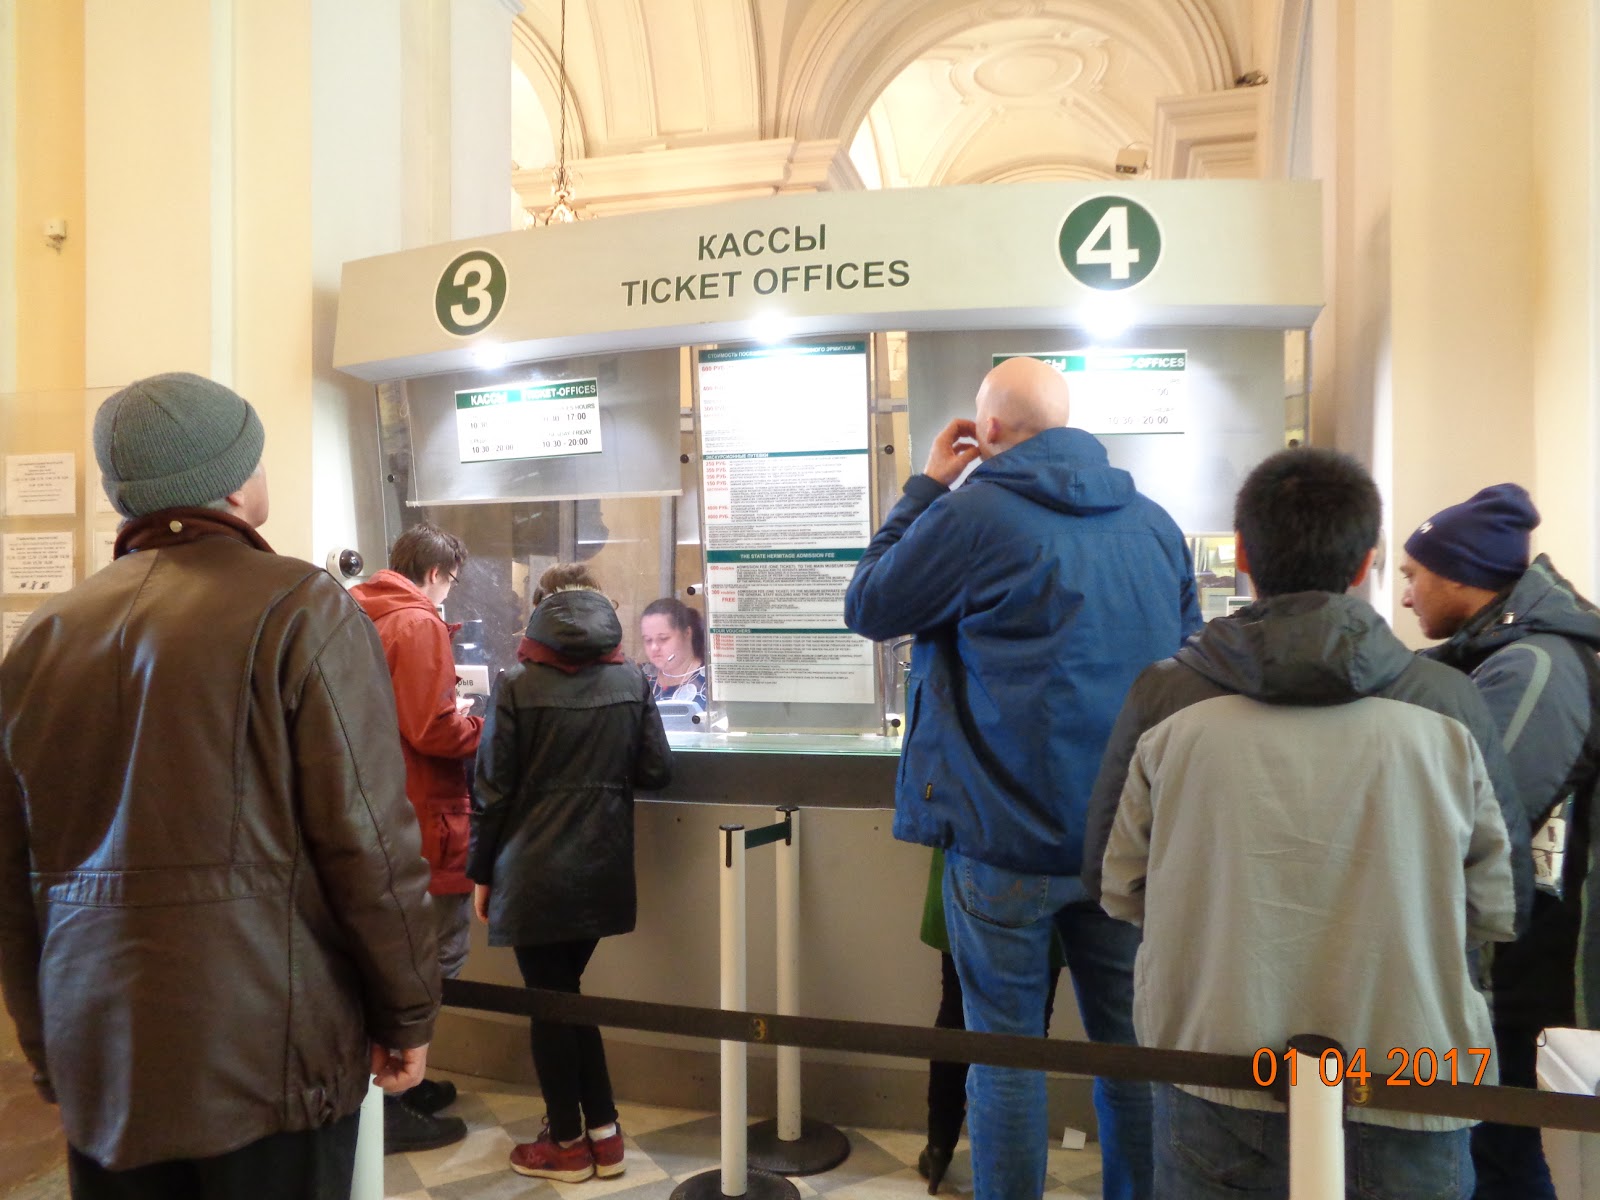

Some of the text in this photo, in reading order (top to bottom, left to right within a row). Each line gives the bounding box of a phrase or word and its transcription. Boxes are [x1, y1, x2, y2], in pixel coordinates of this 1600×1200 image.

[698, 224, 826, 260] КАССЫ
[1076, 206, 1140, 280] 4
[450, 259, 492, 326] 3
[621, 260, 910, 306] TICKET OFFICES
[567, 412, 587, 421] 1700
[472, 445, 490, 454] 1030
[542, 440, 562, 448] 1030
